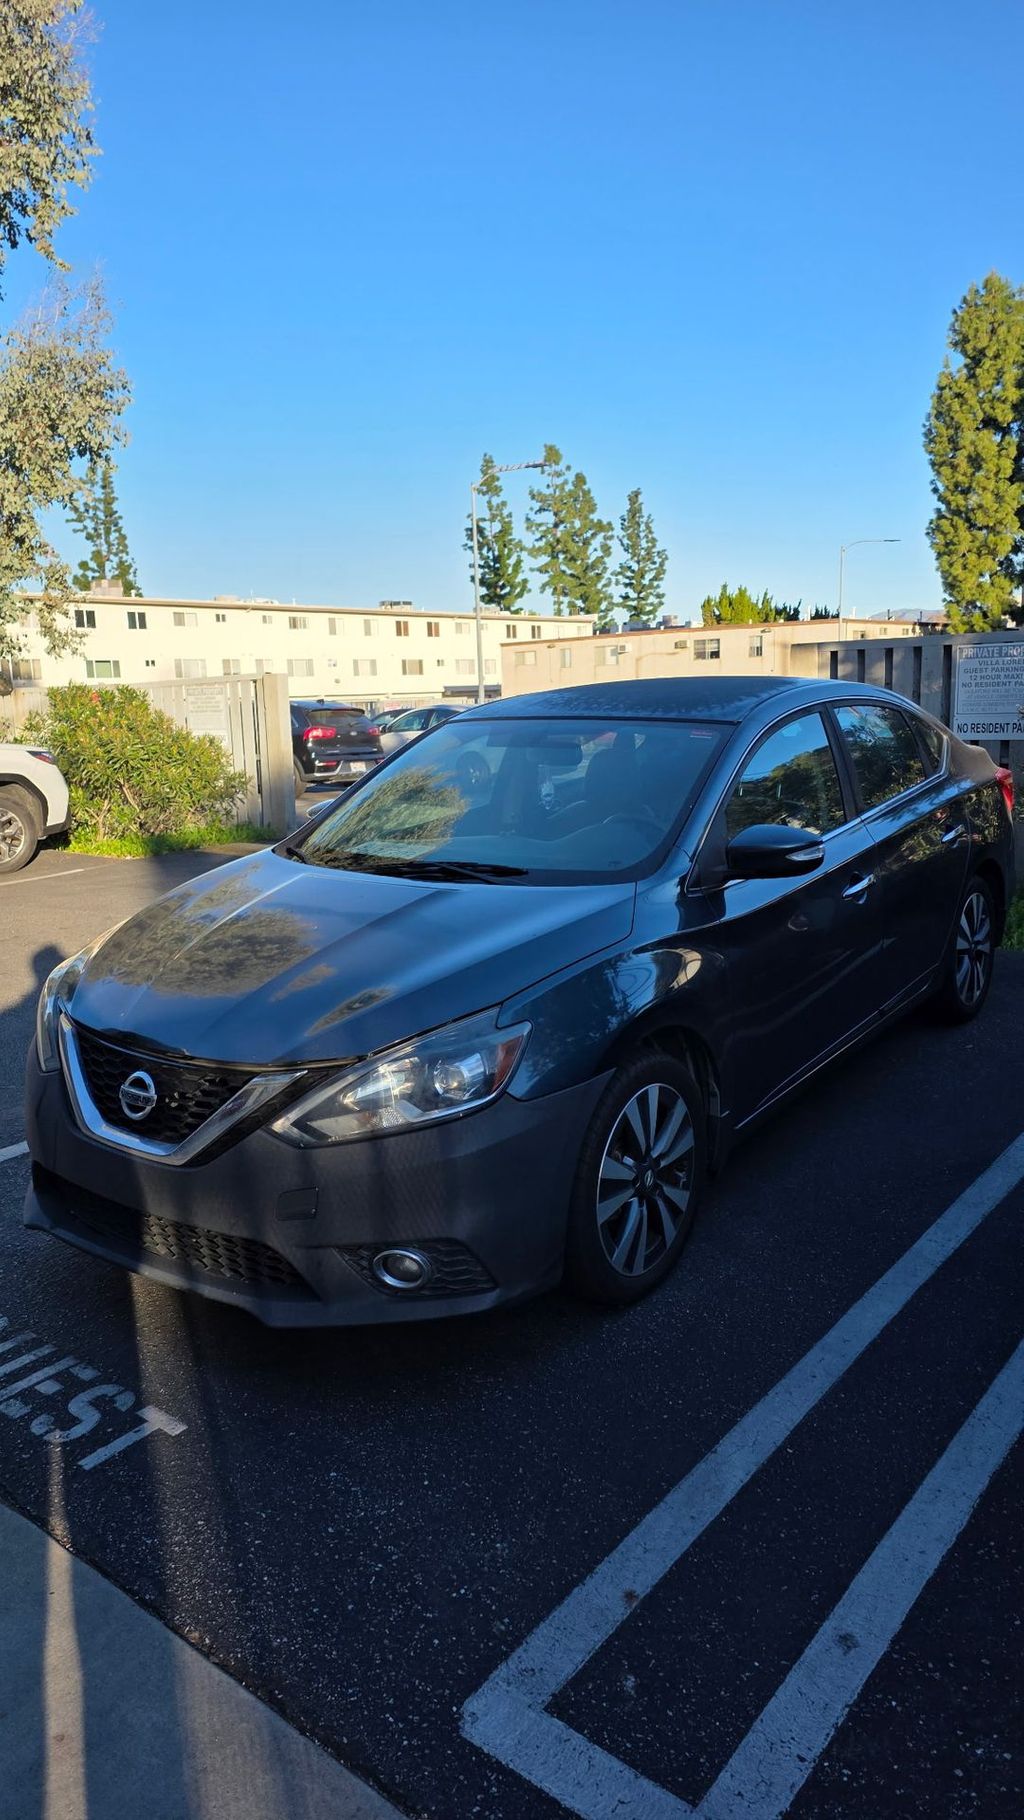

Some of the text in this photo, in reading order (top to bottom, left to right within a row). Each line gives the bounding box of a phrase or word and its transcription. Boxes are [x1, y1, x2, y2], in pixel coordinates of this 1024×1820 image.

[962, 647, 999, 658] PRIVATE
[957, 722, 969, 734] NO
[970, 722, 1011, 734] RESIDENT
